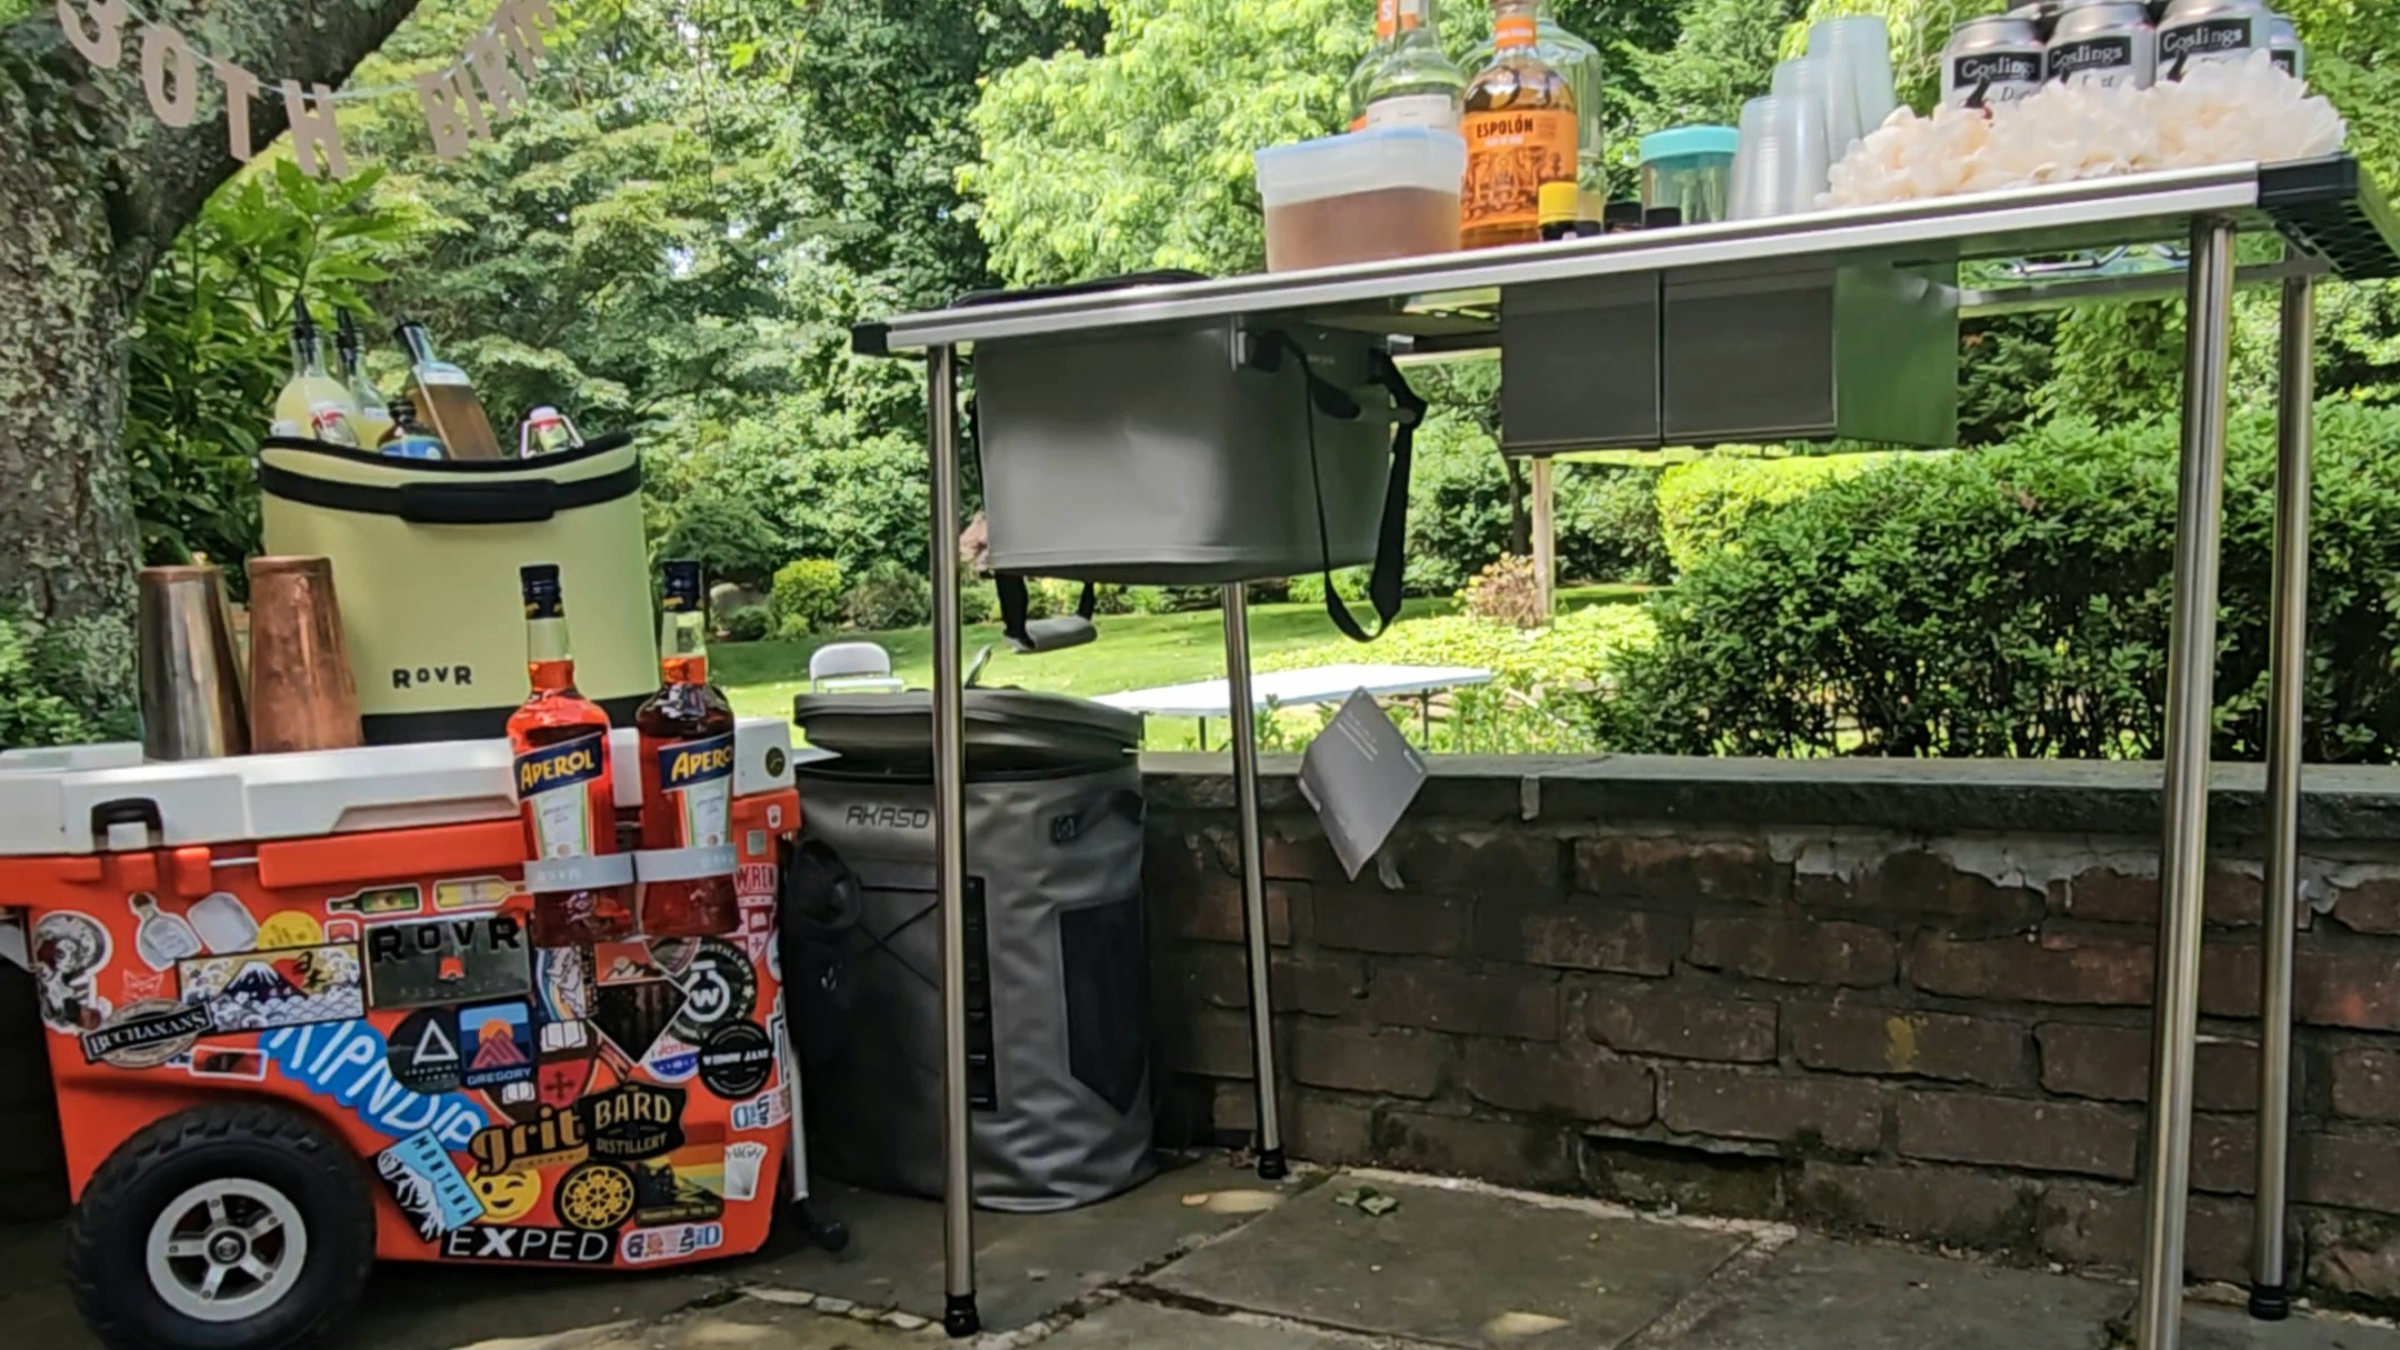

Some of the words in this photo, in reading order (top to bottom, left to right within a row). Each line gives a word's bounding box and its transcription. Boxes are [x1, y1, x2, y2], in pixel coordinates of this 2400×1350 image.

[1477, 114, 1533, 139] ESPOLÓN
[392, 665, 472, 689] ROVR
[520, 749, 596, 791] APEROL
[846, 805, 930, 829] AKASO
[372, 917, 521, 963] ROVR
[467, 1067, 532, 1086] GREGORY
[595, 1092, 672, 1130] BARD
[471, 1105, 585, 1181] grit
[596, 1132, 668, 1155] DISTILLERY
[411, 1136, 476, 1218] MONTANA
[448, 1226, 609, 1262] EXPED
